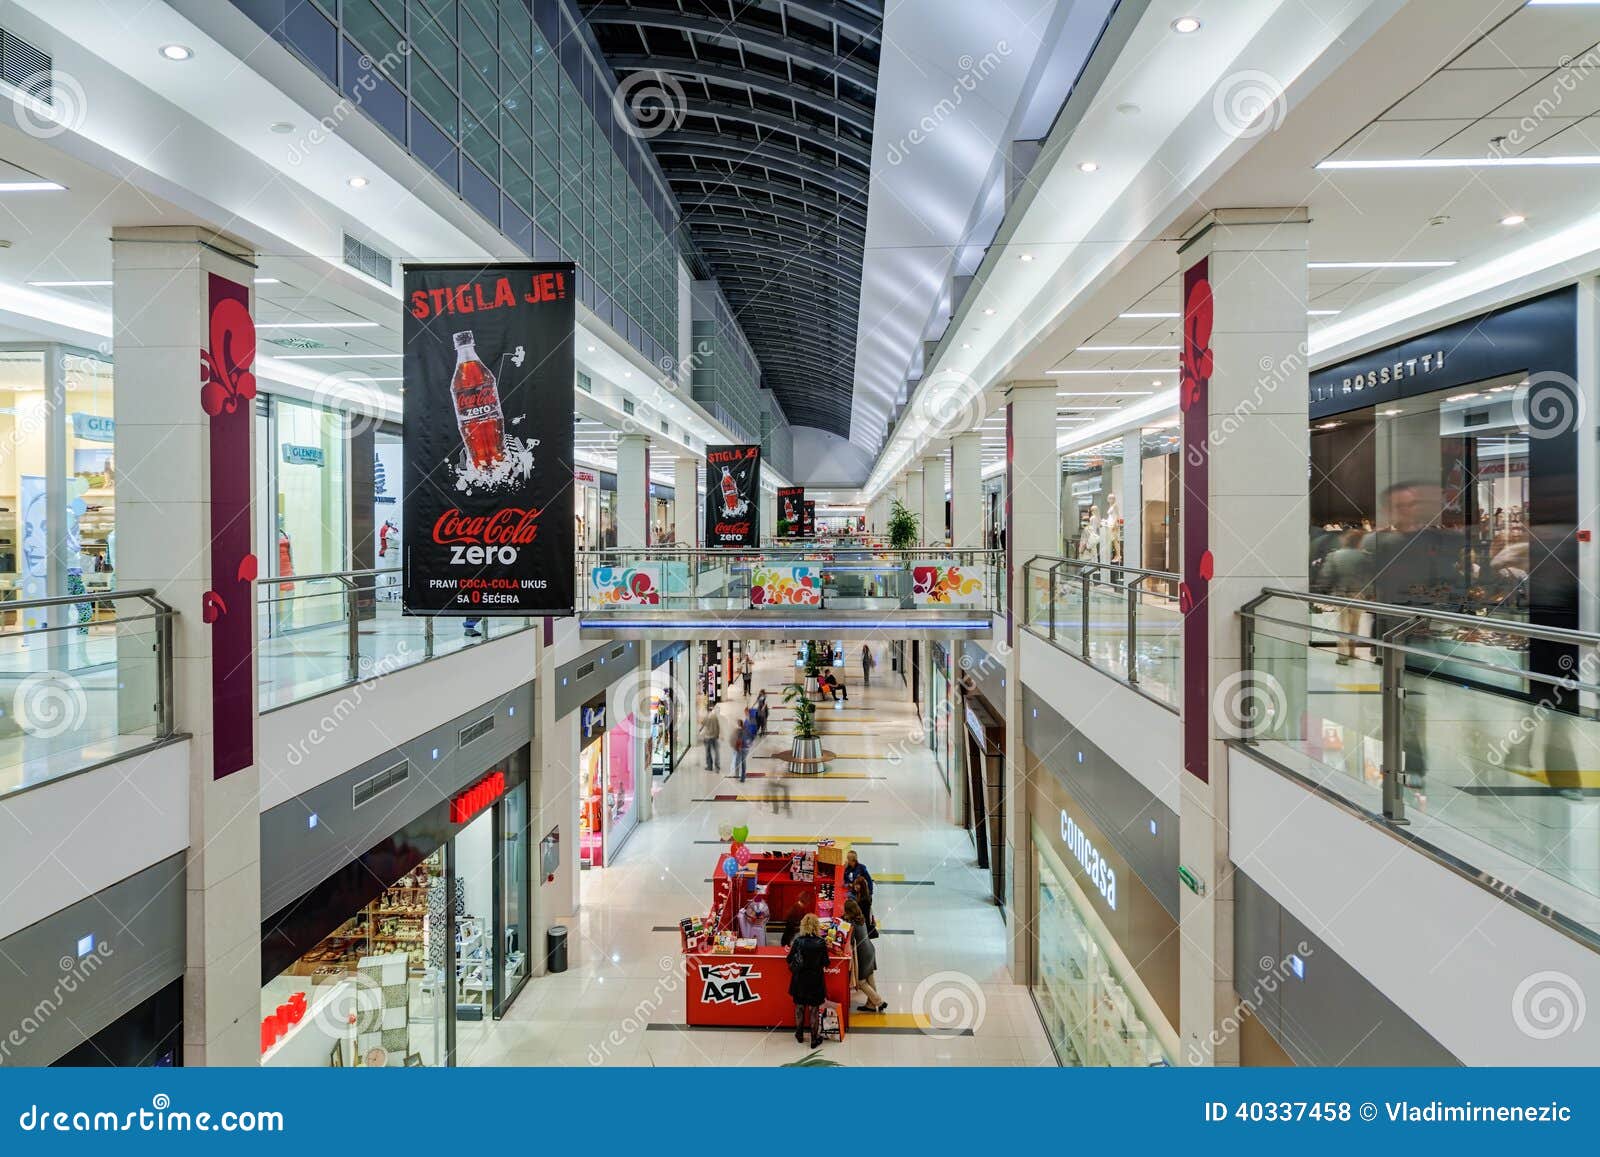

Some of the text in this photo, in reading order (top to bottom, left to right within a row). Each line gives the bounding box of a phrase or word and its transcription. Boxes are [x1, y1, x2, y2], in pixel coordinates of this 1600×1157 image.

[411, 272, 565, 319] STIGLA JE!
[1342, 351, 1444, 393] ROSSETTI
[466, 405, 491, 416] zero
[450, 545, 519, 565] zero
[429, 579, 547, 589] PRAVI COCA-COLA UKUS
[457, 590, 520, 605] SA 0 ŠEĆERA
[1060, 808, 1117, 911] coincasa
